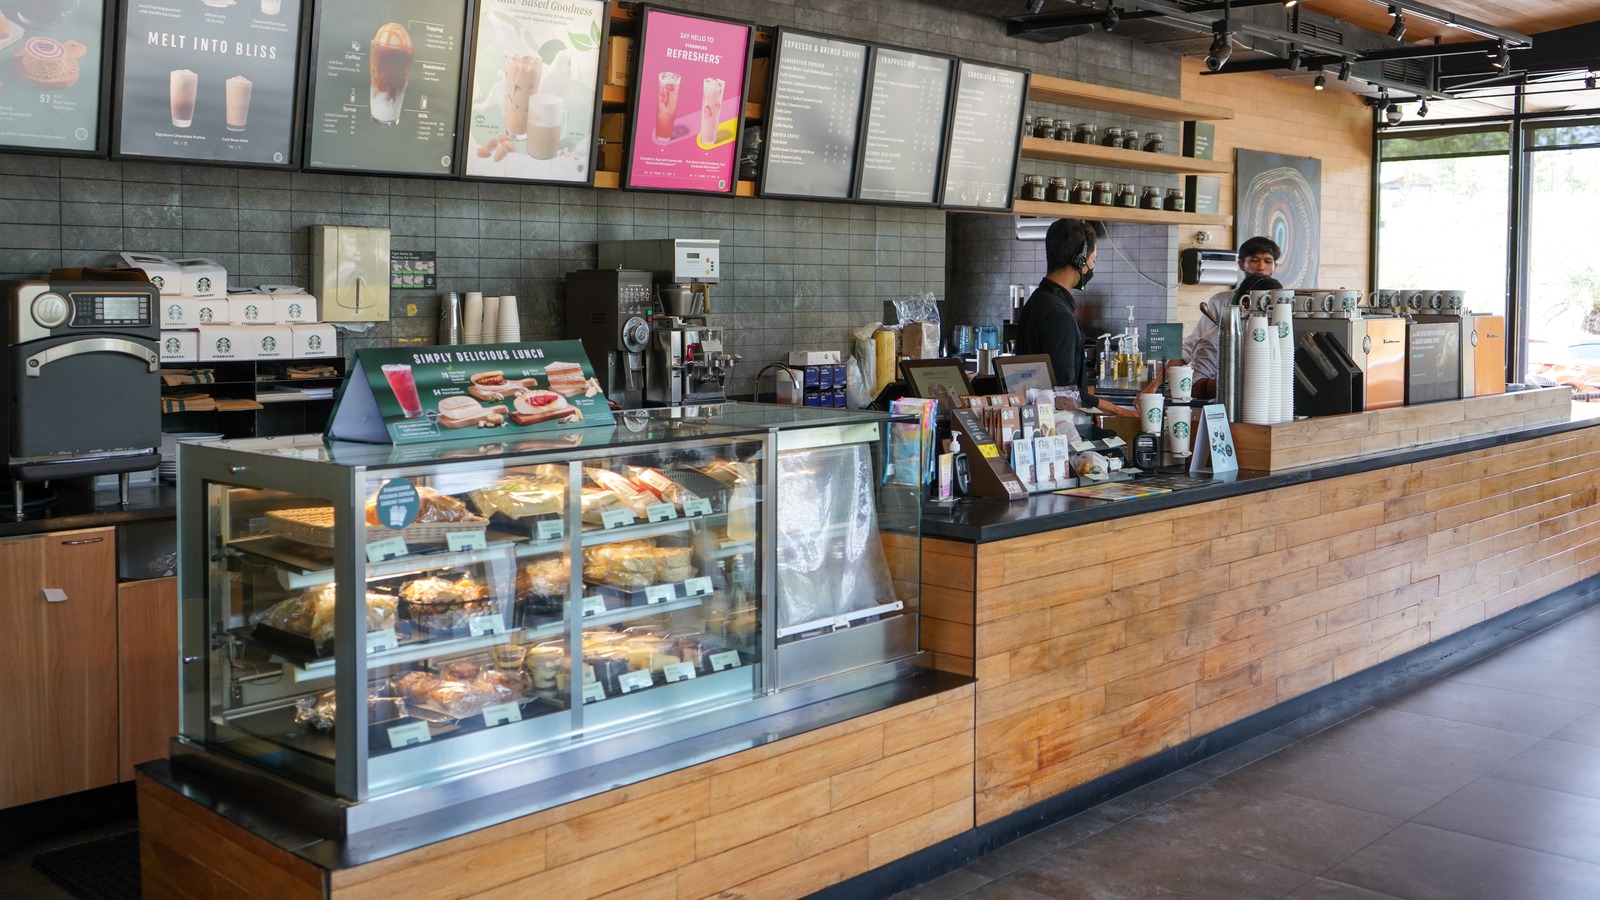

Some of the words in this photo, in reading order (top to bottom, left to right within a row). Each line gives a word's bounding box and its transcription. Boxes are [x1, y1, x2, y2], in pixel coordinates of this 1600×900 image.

[550, 0, 593, 16] Goodness
[148, 31, 186, 48] MELT
[194, 37, 228, 54] INTO
[236, 42, 276, 60] BLISS
[784, 40, 813, 52] ESPRESSO
[820, 45, 840, 56] BREWED
[842, 49, 861, 60] COFFEE
[40, 95, 51, 104] 57
[412, 352, 452, 365] SIMPLY
[456, 350, 510, 363] DELICIOUS
[512, 348, 545, 360] LUNCH
[383, 484, 410, 493] PENANGANAN
